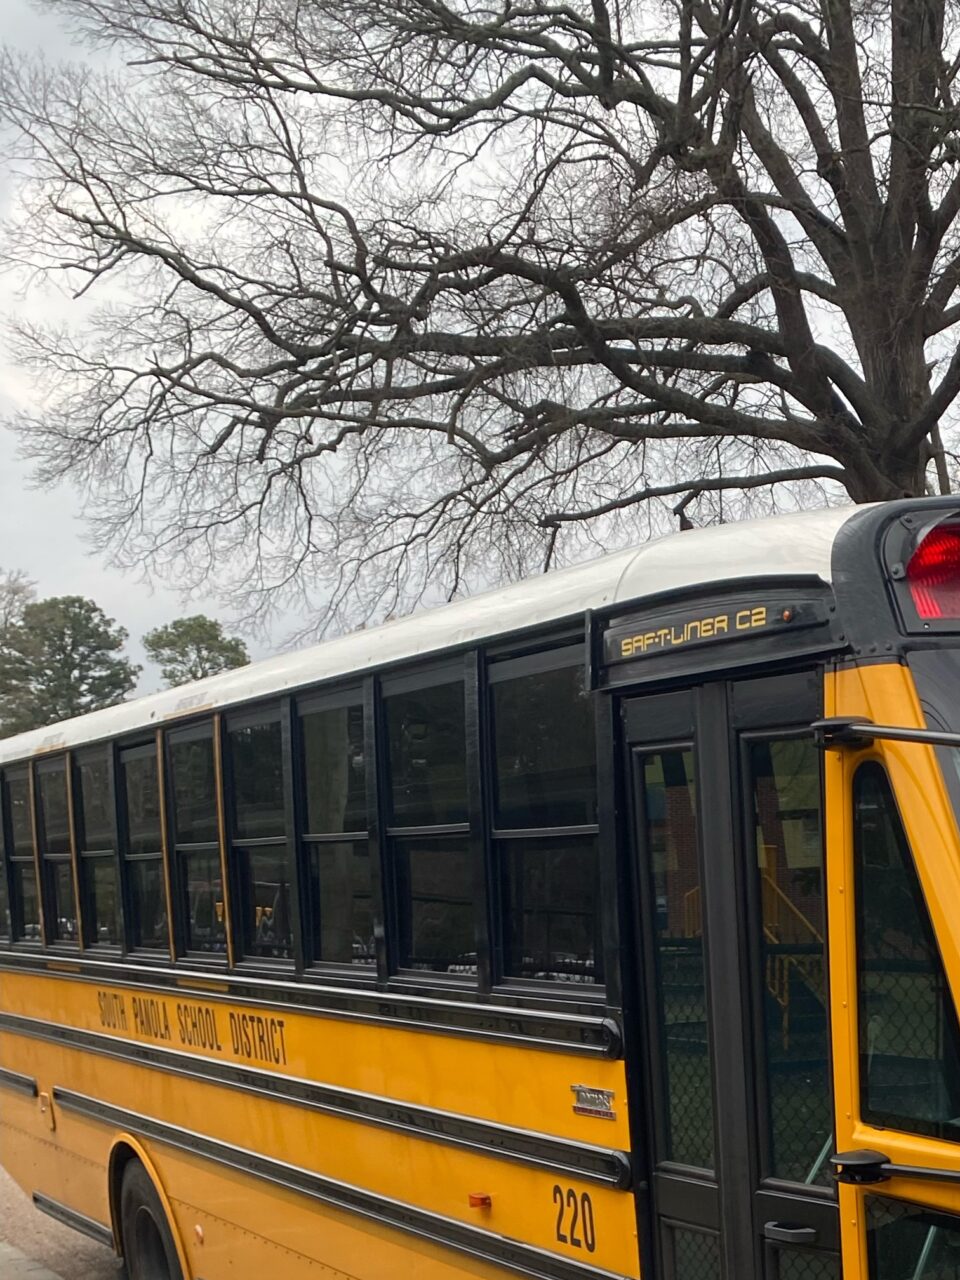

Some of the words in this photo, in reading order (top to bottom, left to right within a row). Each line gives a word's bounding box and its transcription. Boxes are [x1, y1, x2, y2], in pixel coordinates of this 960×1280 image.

[735, 607, 767, 629] C2
[98, 991, 128, 1031] SOUTH
[132, 996, 171, 1041] PANOLA
[176, 1003, 222, 1051] SCHOOL
[229, 1011, 287, 1066] DISTRICT
[553, 1184, 596, 1253] 220
